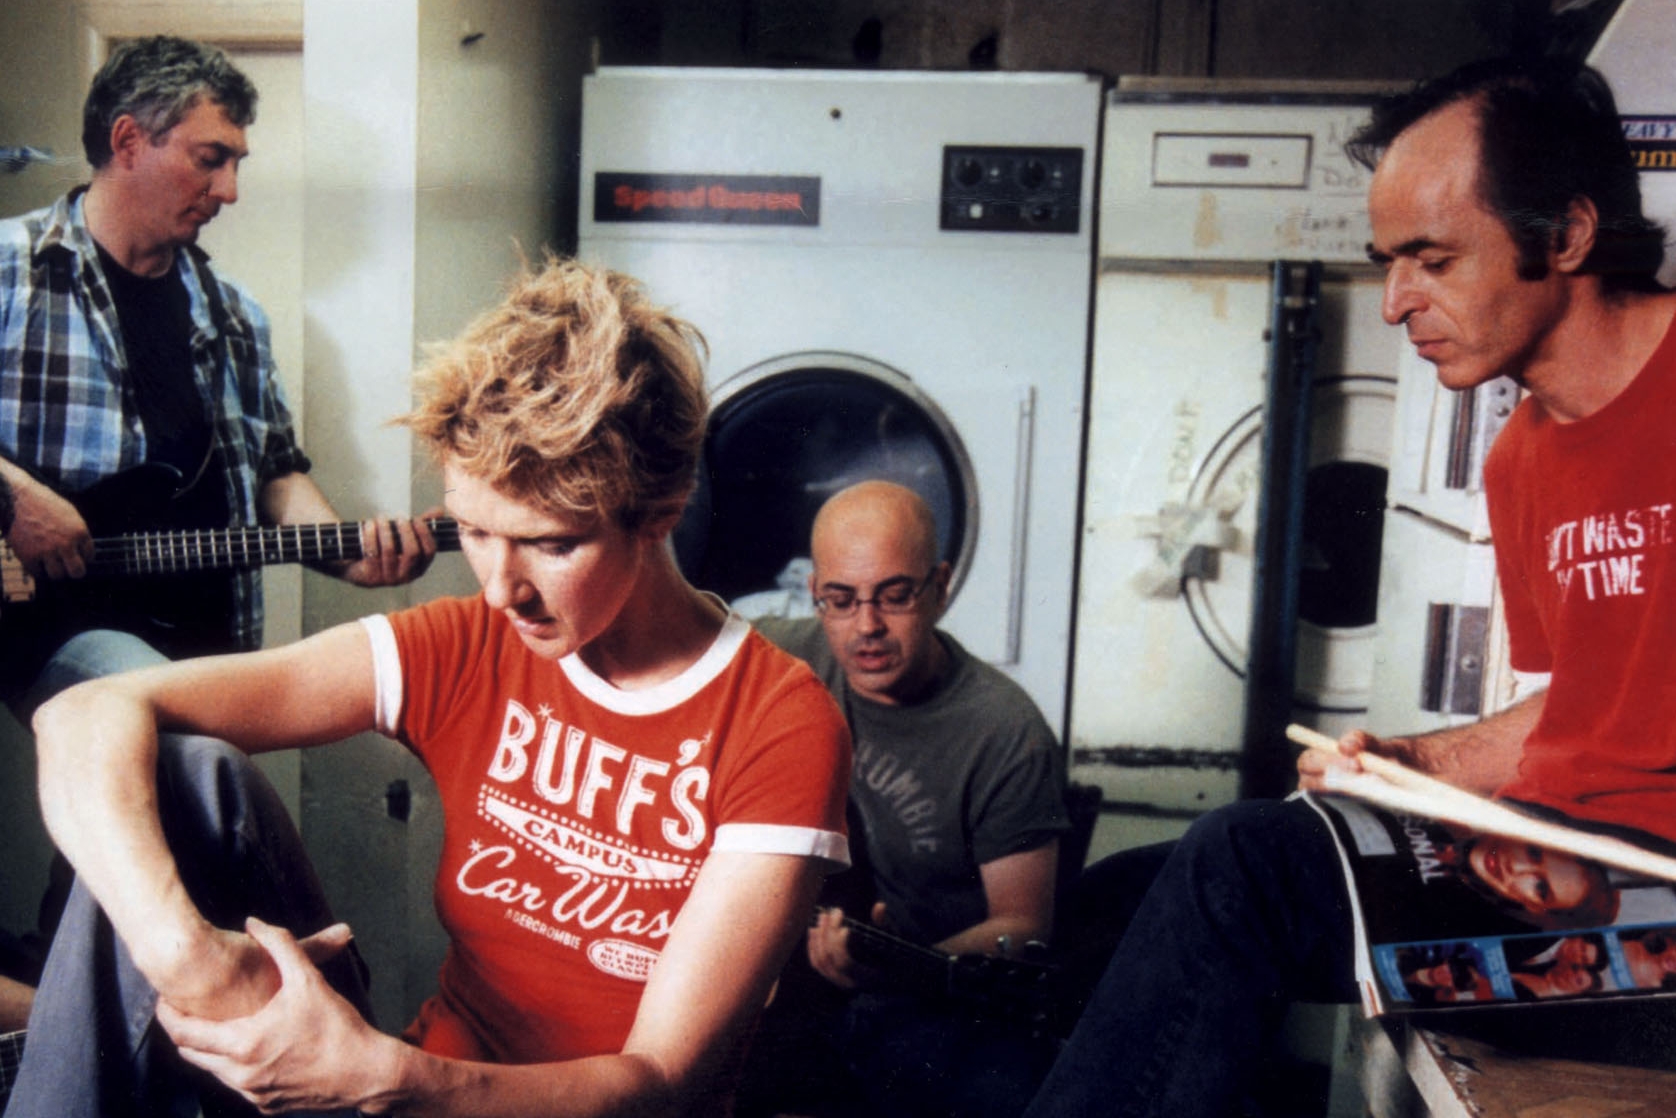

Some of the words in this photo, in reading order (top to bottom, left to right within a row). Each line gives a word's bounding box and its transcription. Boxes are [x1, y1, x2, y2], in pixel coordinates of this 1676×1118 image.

[1576, 553, 1646, 601] TIME
[487, 698, 712, 851] BUFF'S
[522, 818, 642, 875] CAMPUS
[456, 845, 547, 911] Car
[551, 863, 674, 938] Was
[503, 908, 583, 950] ABERCROMBIE
